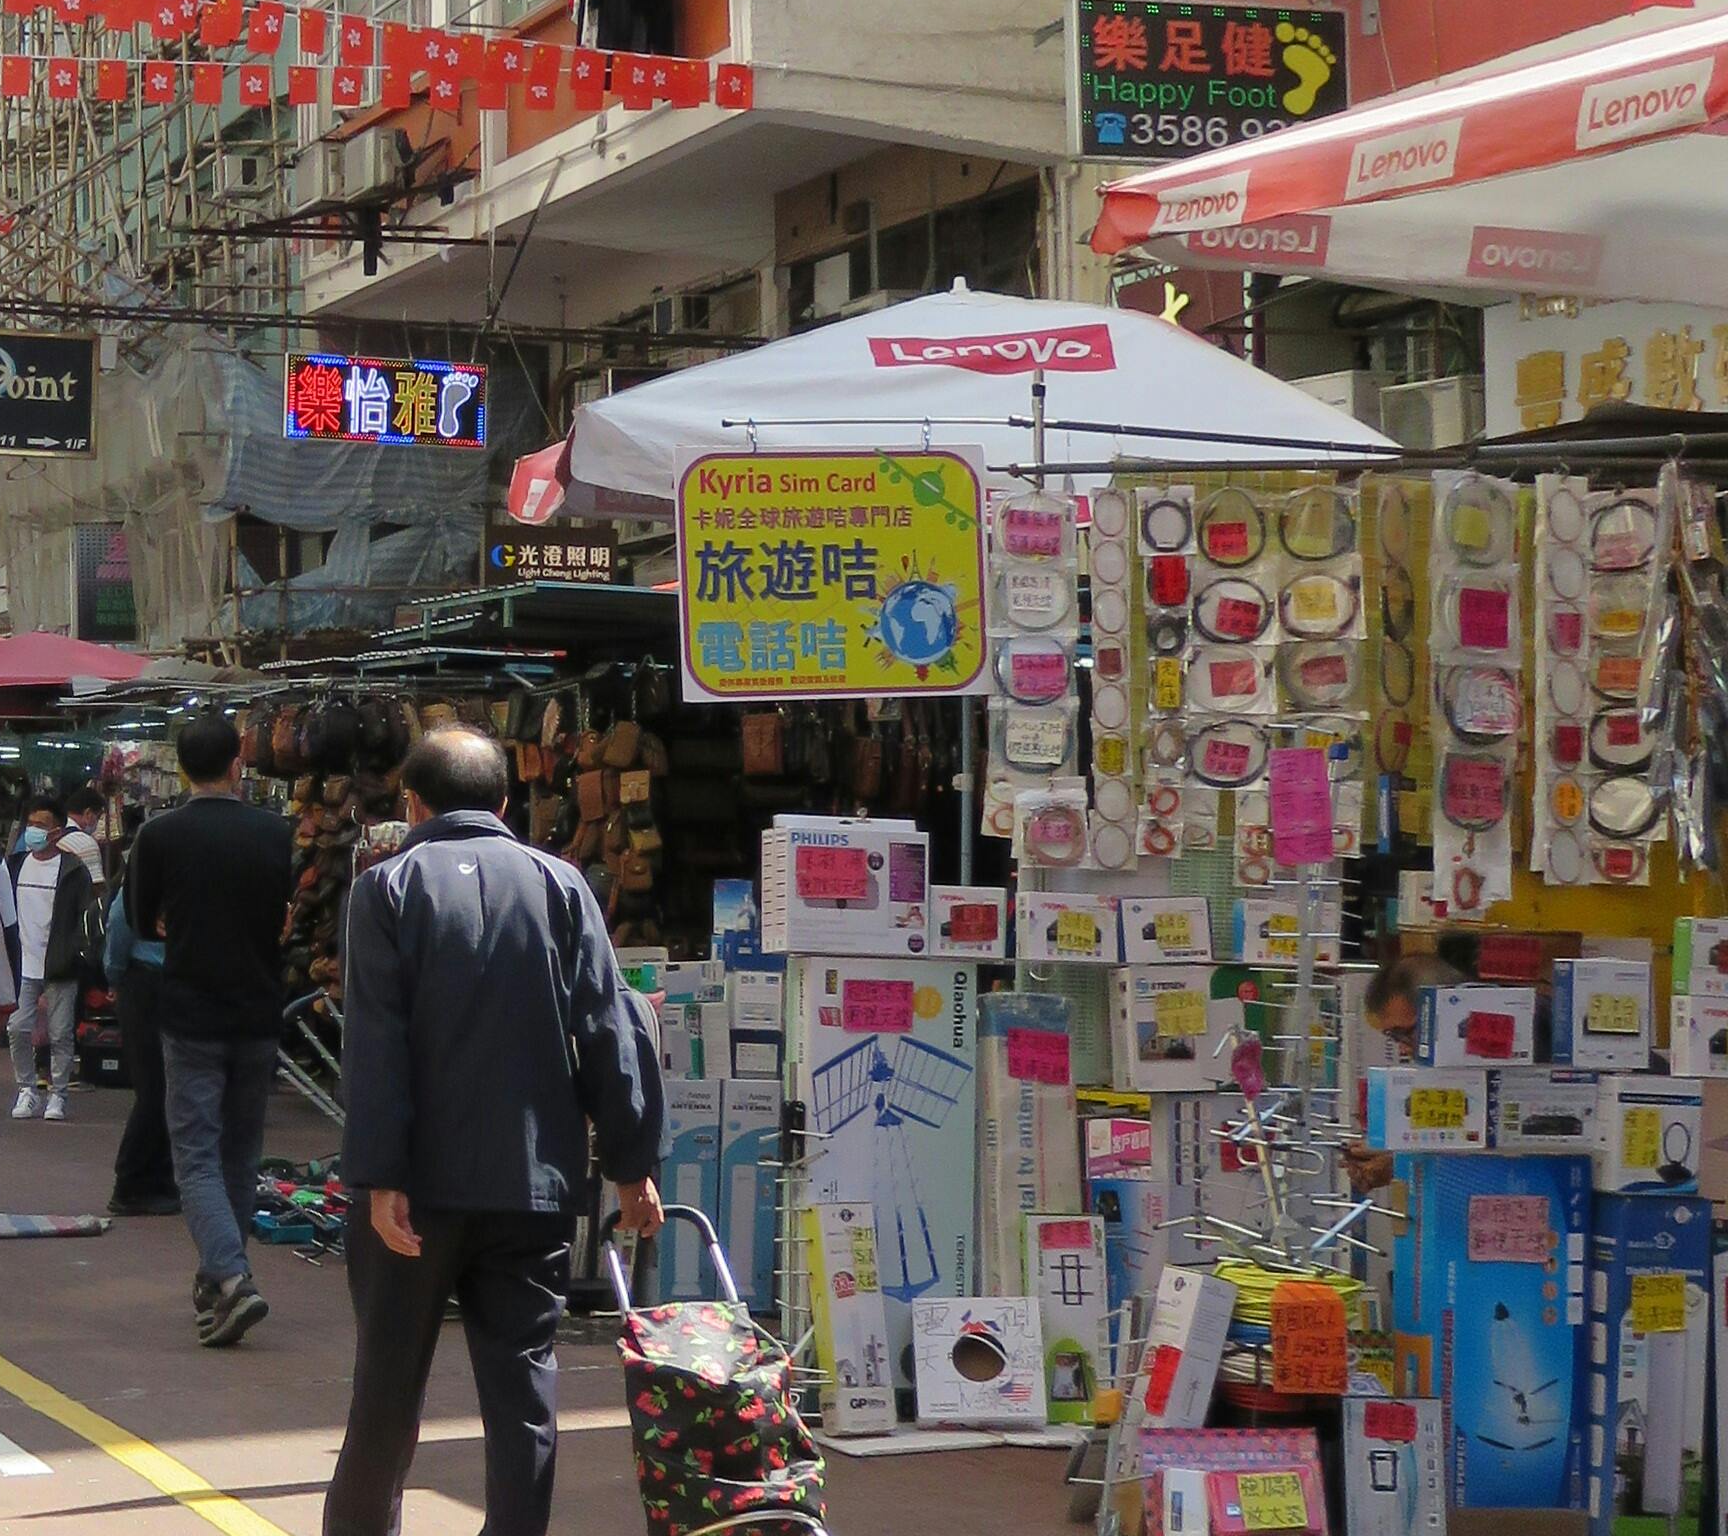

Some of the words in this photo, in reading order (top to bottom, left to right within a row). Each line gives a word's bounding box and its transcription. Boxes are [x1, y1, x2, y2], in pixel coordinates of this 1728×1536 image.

[1092, 14, 1276, 78] 樂足健
[1093, 75, 1196, 110] Happy
[1208, 80, 1277, 109] Foot
[1588, 81, 1698, 130] Lenovo
[1130, 113, 1229, 148] 3586
[1356, 139, 1449, 183] Lenovo
[1162, 191, 1239, 224] Lenovo
[890, 337, 1091, 364] Lenovo
[1515, 325, 1728, 431] 豐成數
[297, 365, 437, 436] 樂怡雅
[699, 467, 772, 499] Kyria
[780, 475, 819, 493] Sim
[827, 473, 876, 493] Card
[518, 545, 610, 567] 光澄照明
[695, 538, 878, 602] 旅遊咭
[697, 619, 847, 671] 電話咭
[790, 831, 849, 846] PHILIPS
[952, 971, 968, 1049] Qiaohua
